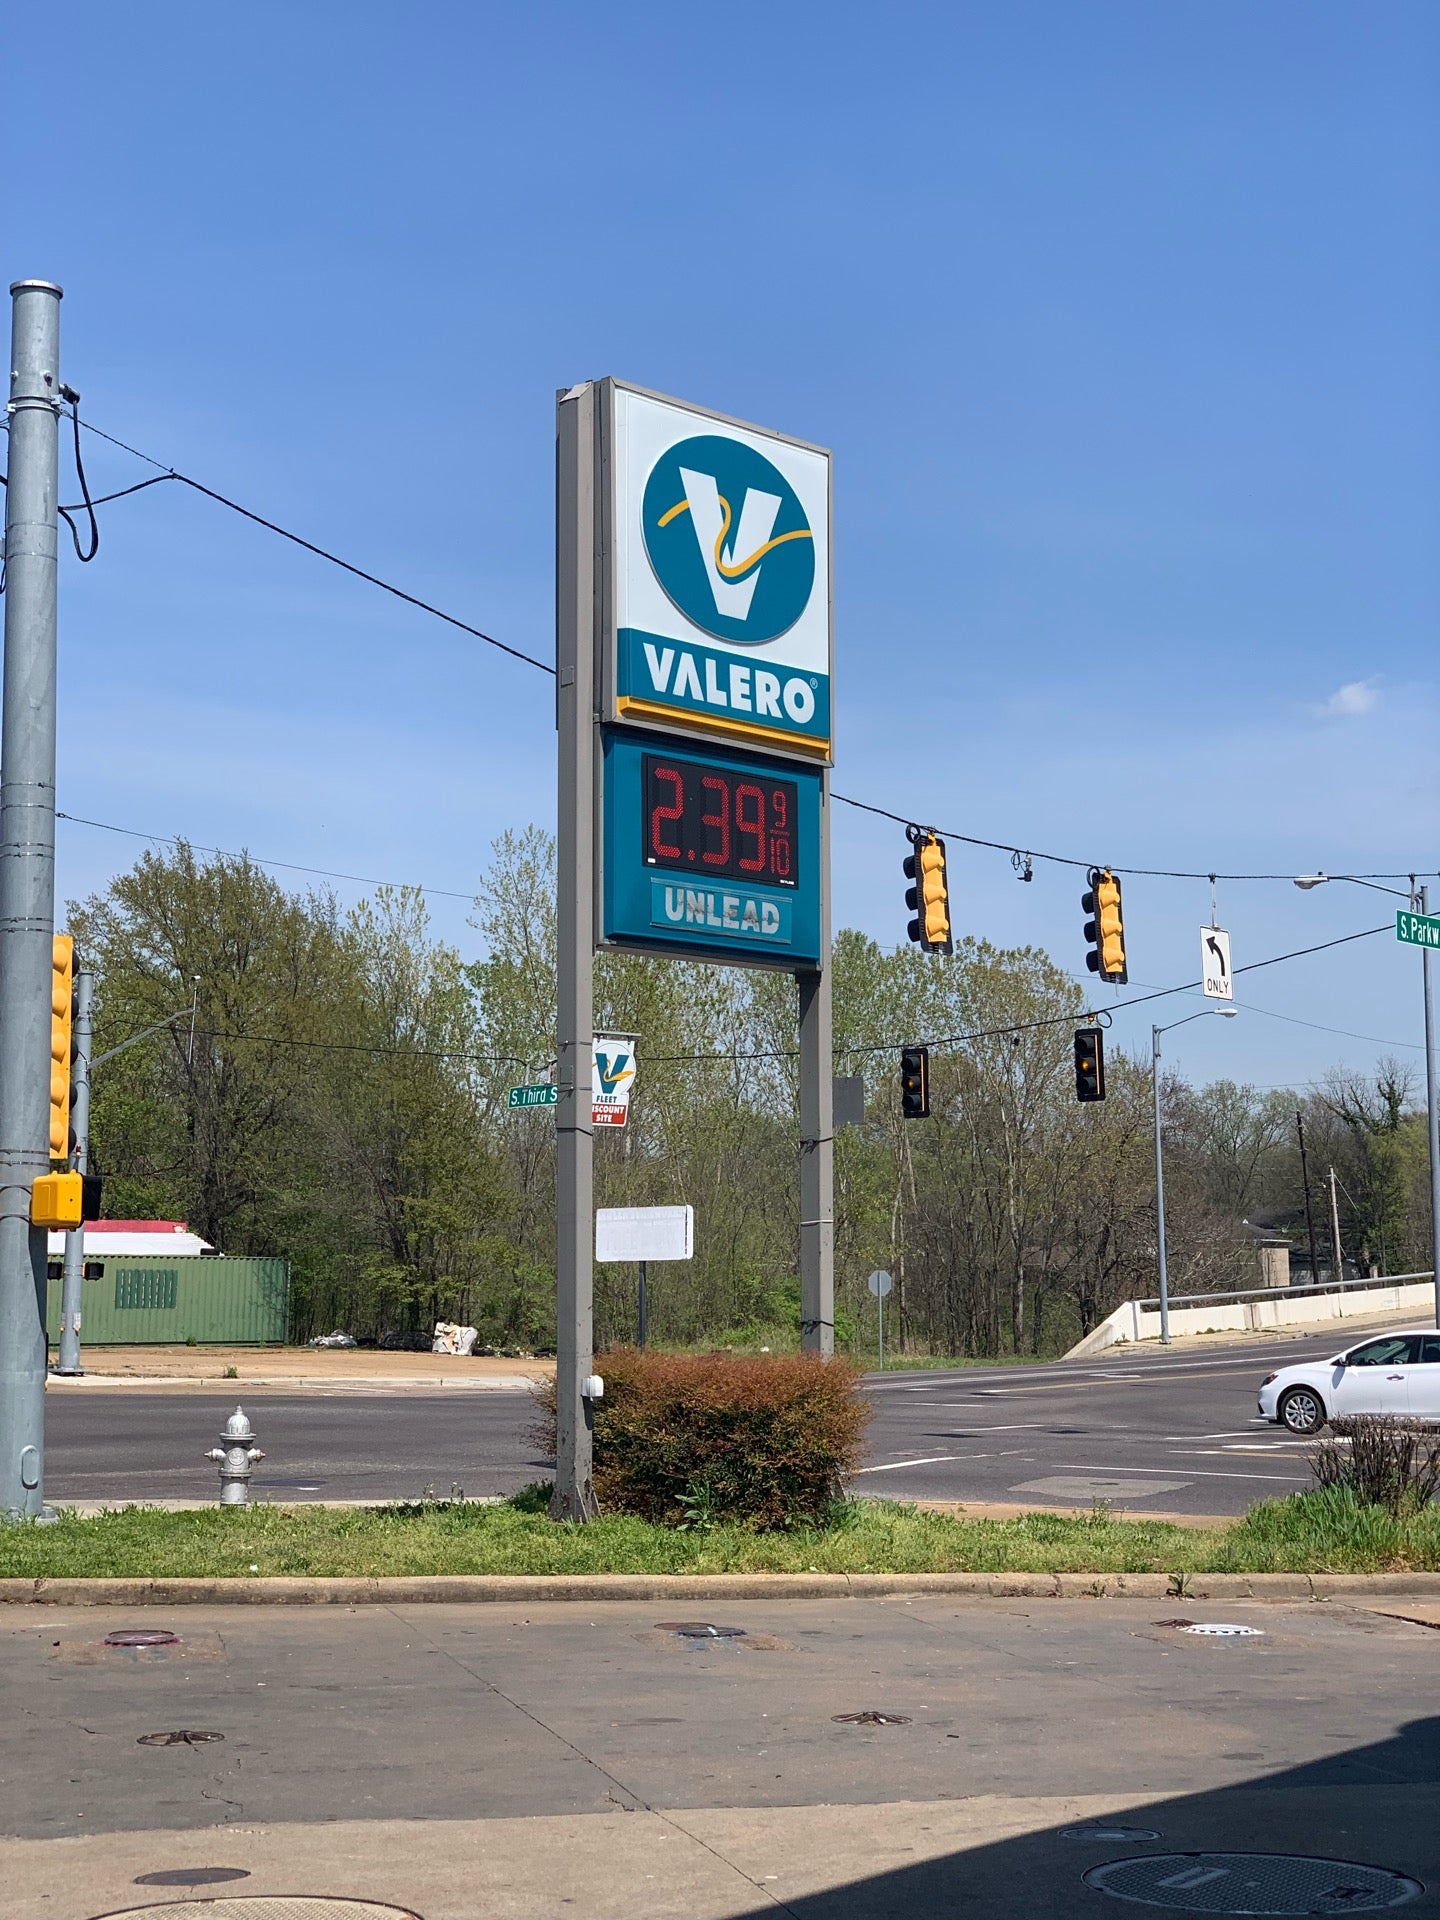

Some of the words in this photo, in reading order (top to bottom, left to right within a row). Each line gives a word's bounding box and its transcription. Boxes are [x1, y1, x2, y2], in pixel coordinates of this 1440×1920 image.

[679, 466, 782, 621] V
[643, 643, 815, 724] VALERO
[652, 767, 766, 872] 2.39
[769, 837, 790, 876] 10
[665, 887, 779, 934] UNLEAD
[1401, 915, 1409, 939] S.
[1411, 918, 1440, 945] Parkw
[1207, 978, 1229, 994] ONLY
[511, 1090, 520, 1105] S.
[522, 1087, 547, 1104] Third
[596, 1095, 618, 1104] FLEET
[596, 1114, 613, 1123] SITE
